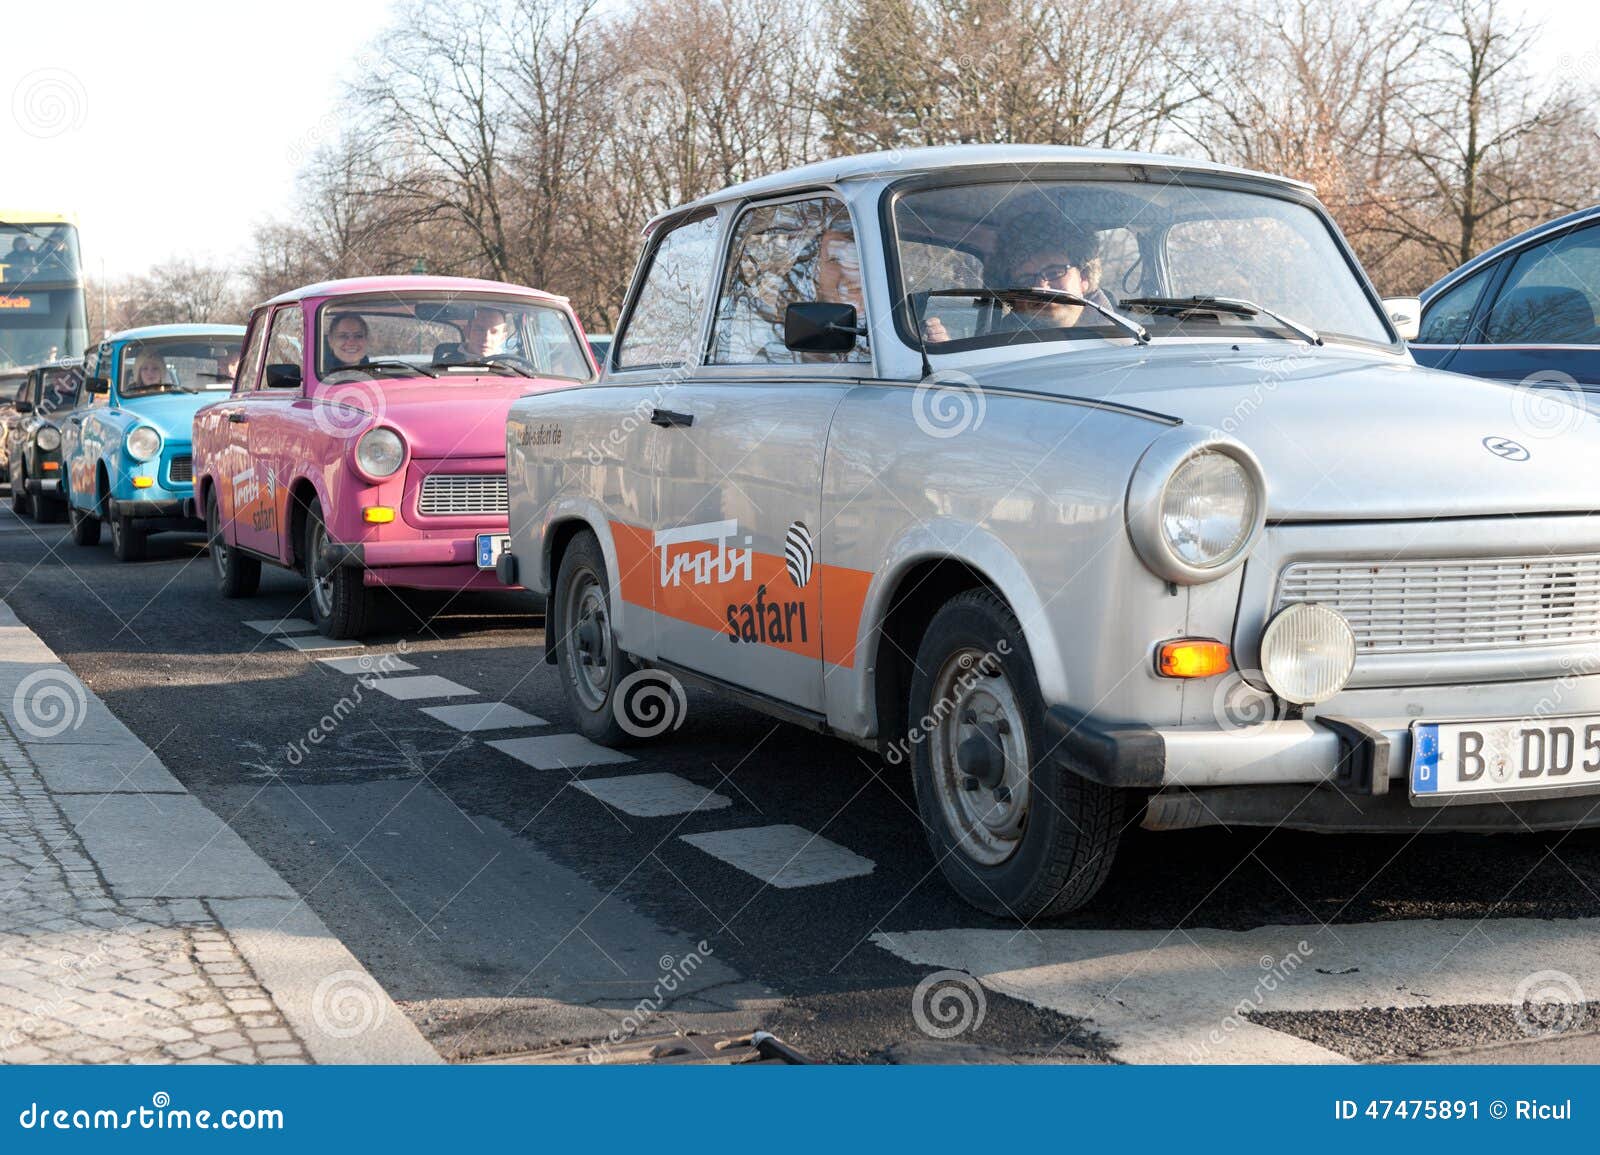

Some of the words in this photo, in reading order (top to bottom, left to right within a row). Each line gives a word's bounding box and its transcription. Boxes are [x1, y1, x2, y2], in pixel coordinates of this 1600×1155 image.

[654, 518, 754, 588] Trabi
[726, 584, 809, 644] safari
[1458, 730, 1486, 782] B
